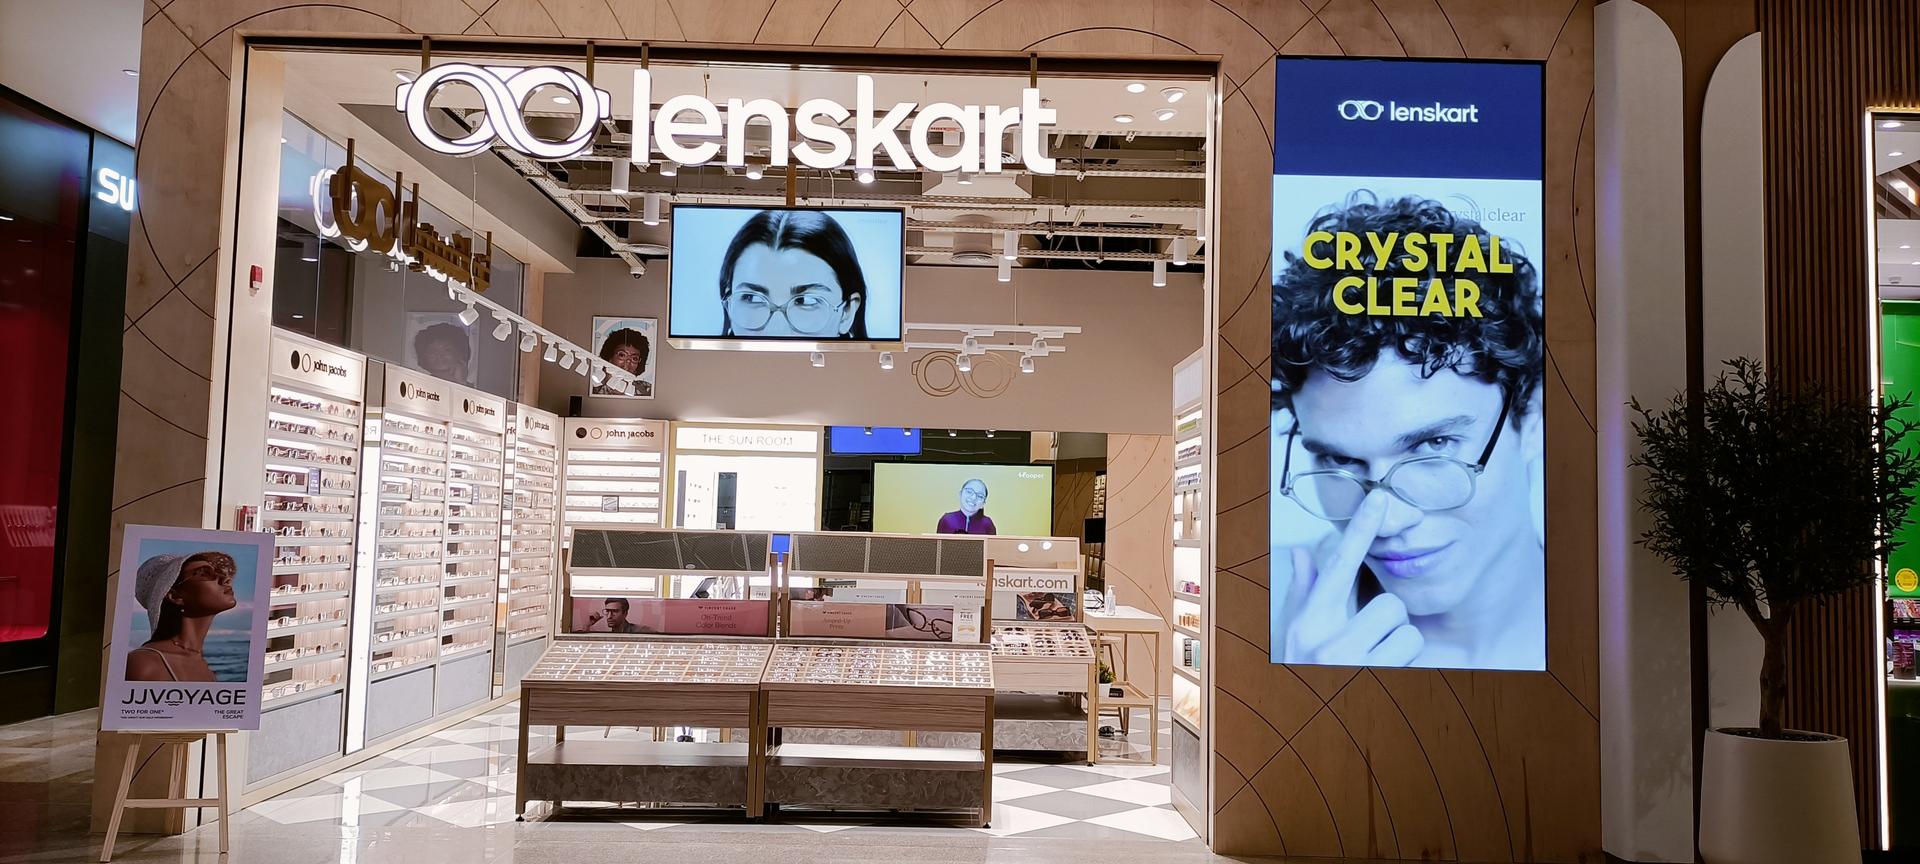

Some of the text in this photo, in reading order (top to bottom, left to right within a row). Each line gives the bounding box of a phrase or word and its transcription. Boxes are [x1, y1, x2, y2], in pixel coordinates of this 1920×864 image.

[631, 68, 1057, 175] lenskart
[1390, 100, 1479, 123] lenskart
[1302, 231, 1514, 274] CRYSTAL
[1332, 276, 1484, 318] CLEAR
[313, 359, 347, 378] john jacobs
[605, 429, 655, 439] john jacobs
[703, 433, 793, 446] THE SUN ROOM
[121, 688, 247, 706] JJVOYAGE
